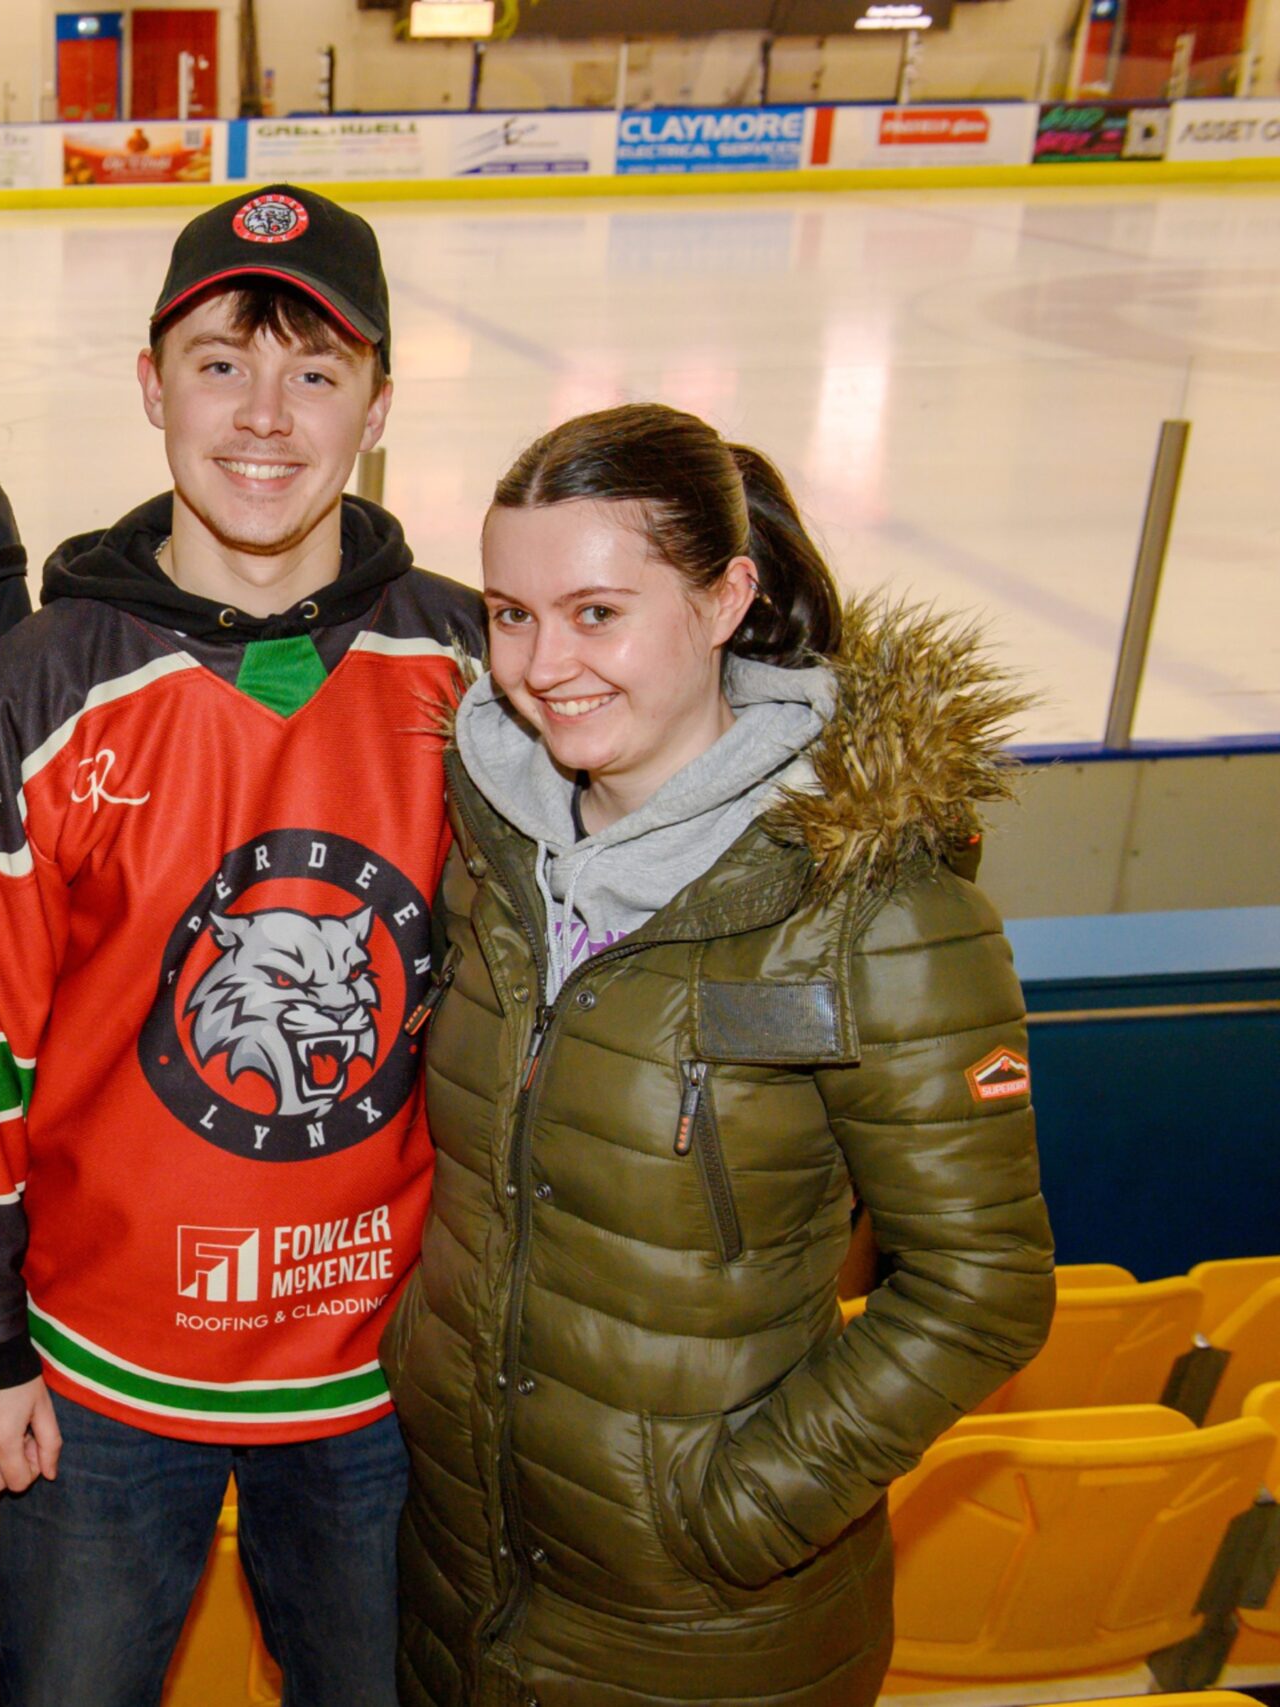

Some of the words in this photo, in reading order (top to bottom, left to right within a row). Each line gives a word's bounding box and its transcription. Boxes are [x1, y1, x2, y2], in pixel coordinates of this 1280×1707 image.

[621, 112, 802, 143] CLAYMORE
[1177, 118, 1260, 143] ASSET
[200, 1096, 382, 1150] LYNX
[274, 1205, 392, 1265] FOWLER
[176, 1312, 269, 1331] ROOFING
[274, 1310, 286, 1324] &
